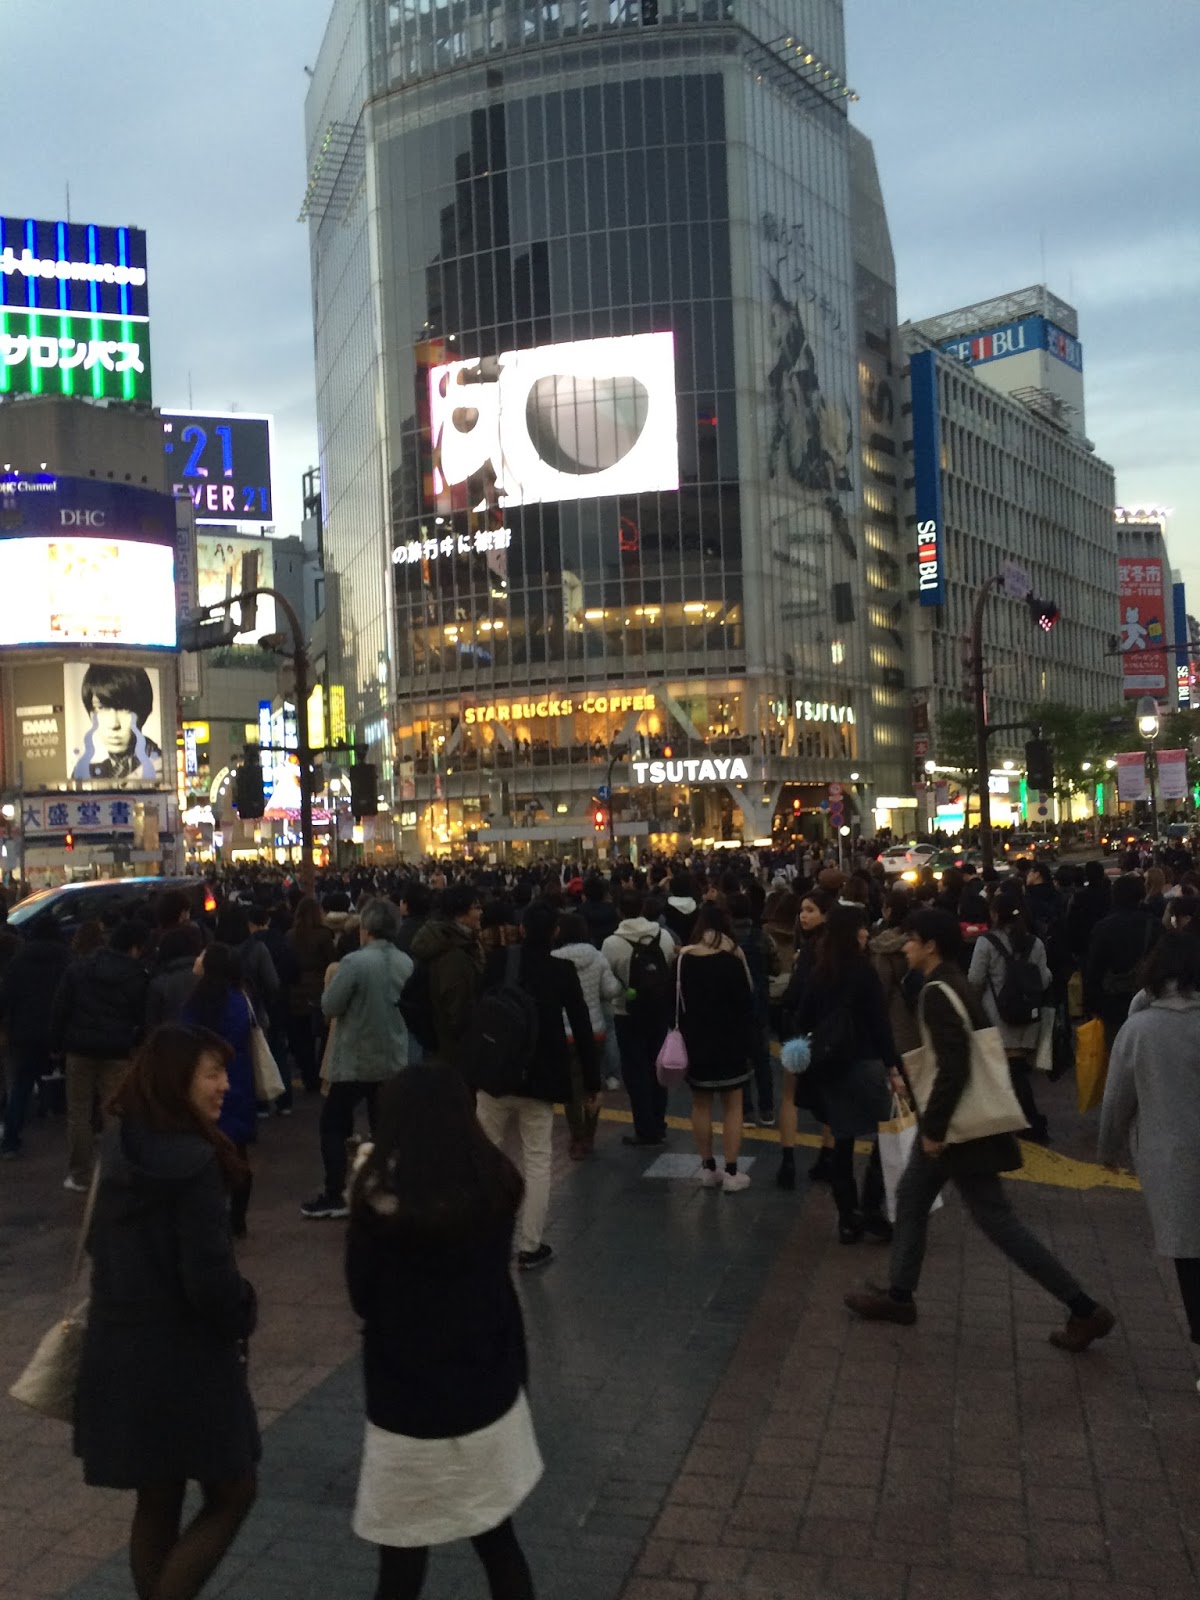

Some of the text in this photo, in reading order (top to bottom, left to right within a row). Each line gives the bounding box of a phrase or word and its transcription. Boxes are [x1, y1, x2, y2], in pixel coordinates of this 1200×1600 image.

[0, 333, 145, 373] サロンパス
[181, 424, 233, 478] 21
[18, 481, 57, 492] Channel
[242, 486, 268, 513] 21
[60, 509, 105, 527] DHC
[917, 519, 938, 591] SEIBU
[1176, 665, 1190, 701] SEIBU
[464, 694, 656, 725] STARBUCKS COFFEE
[795, 700, 858, 725] TSUTAYA
[22, 718, 59, 735] DMM
[22, 733, 59, 747] mobile
[632, 758, 749, 784] TSUTAYA
